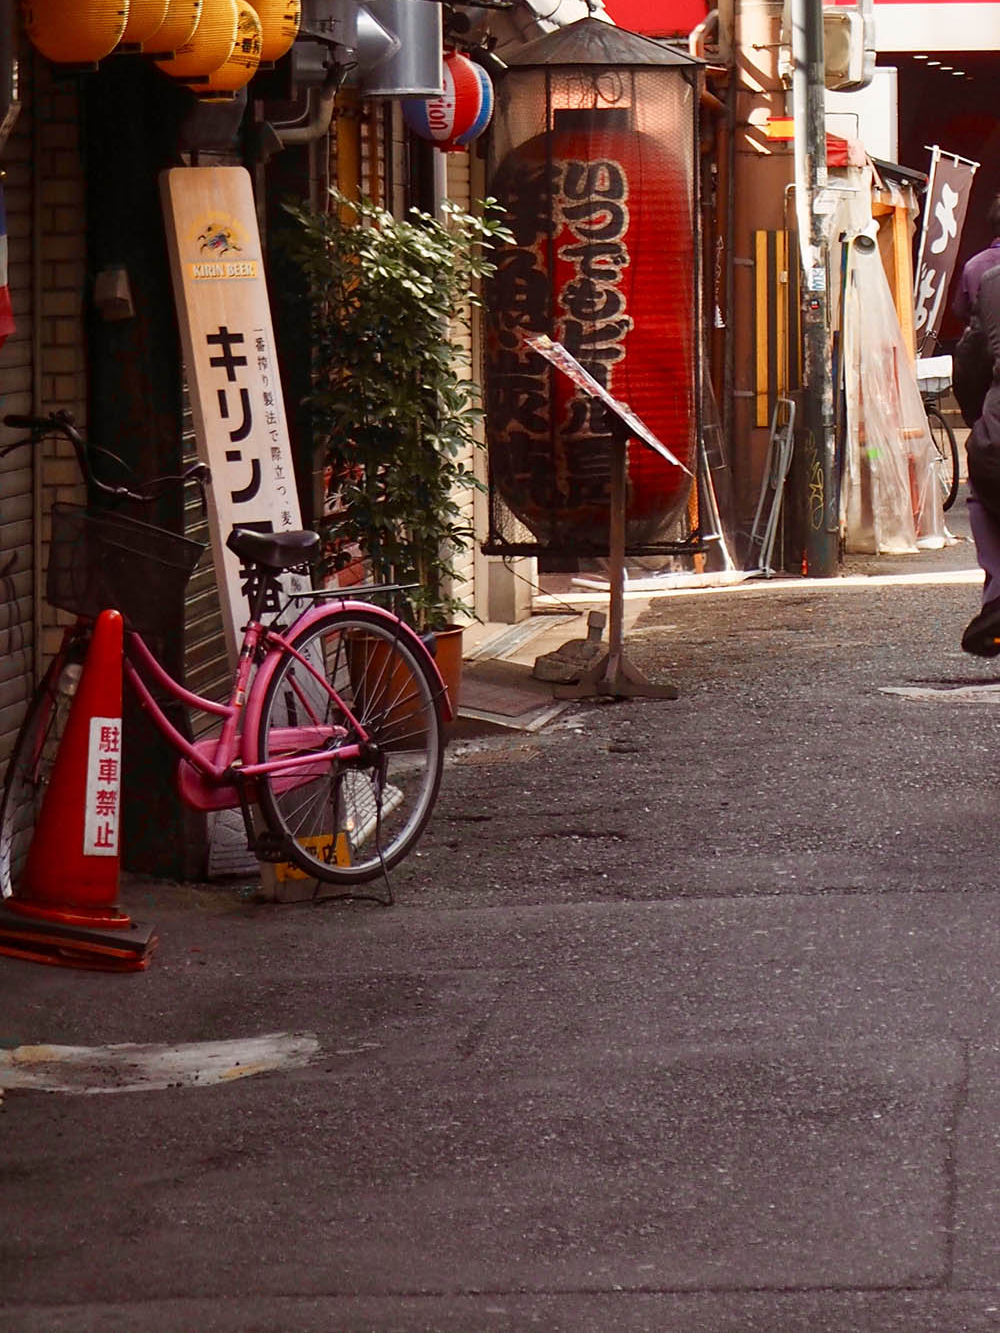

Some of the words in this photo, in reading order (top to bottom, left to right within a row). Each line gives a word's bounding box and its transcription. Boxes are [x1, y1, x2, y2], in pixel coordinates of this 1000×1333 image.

[193, 265, 225, 278] KIRIN
[227, 263, 255, 277] BEER
[94, 726, 120, 848] 駐車禁止
